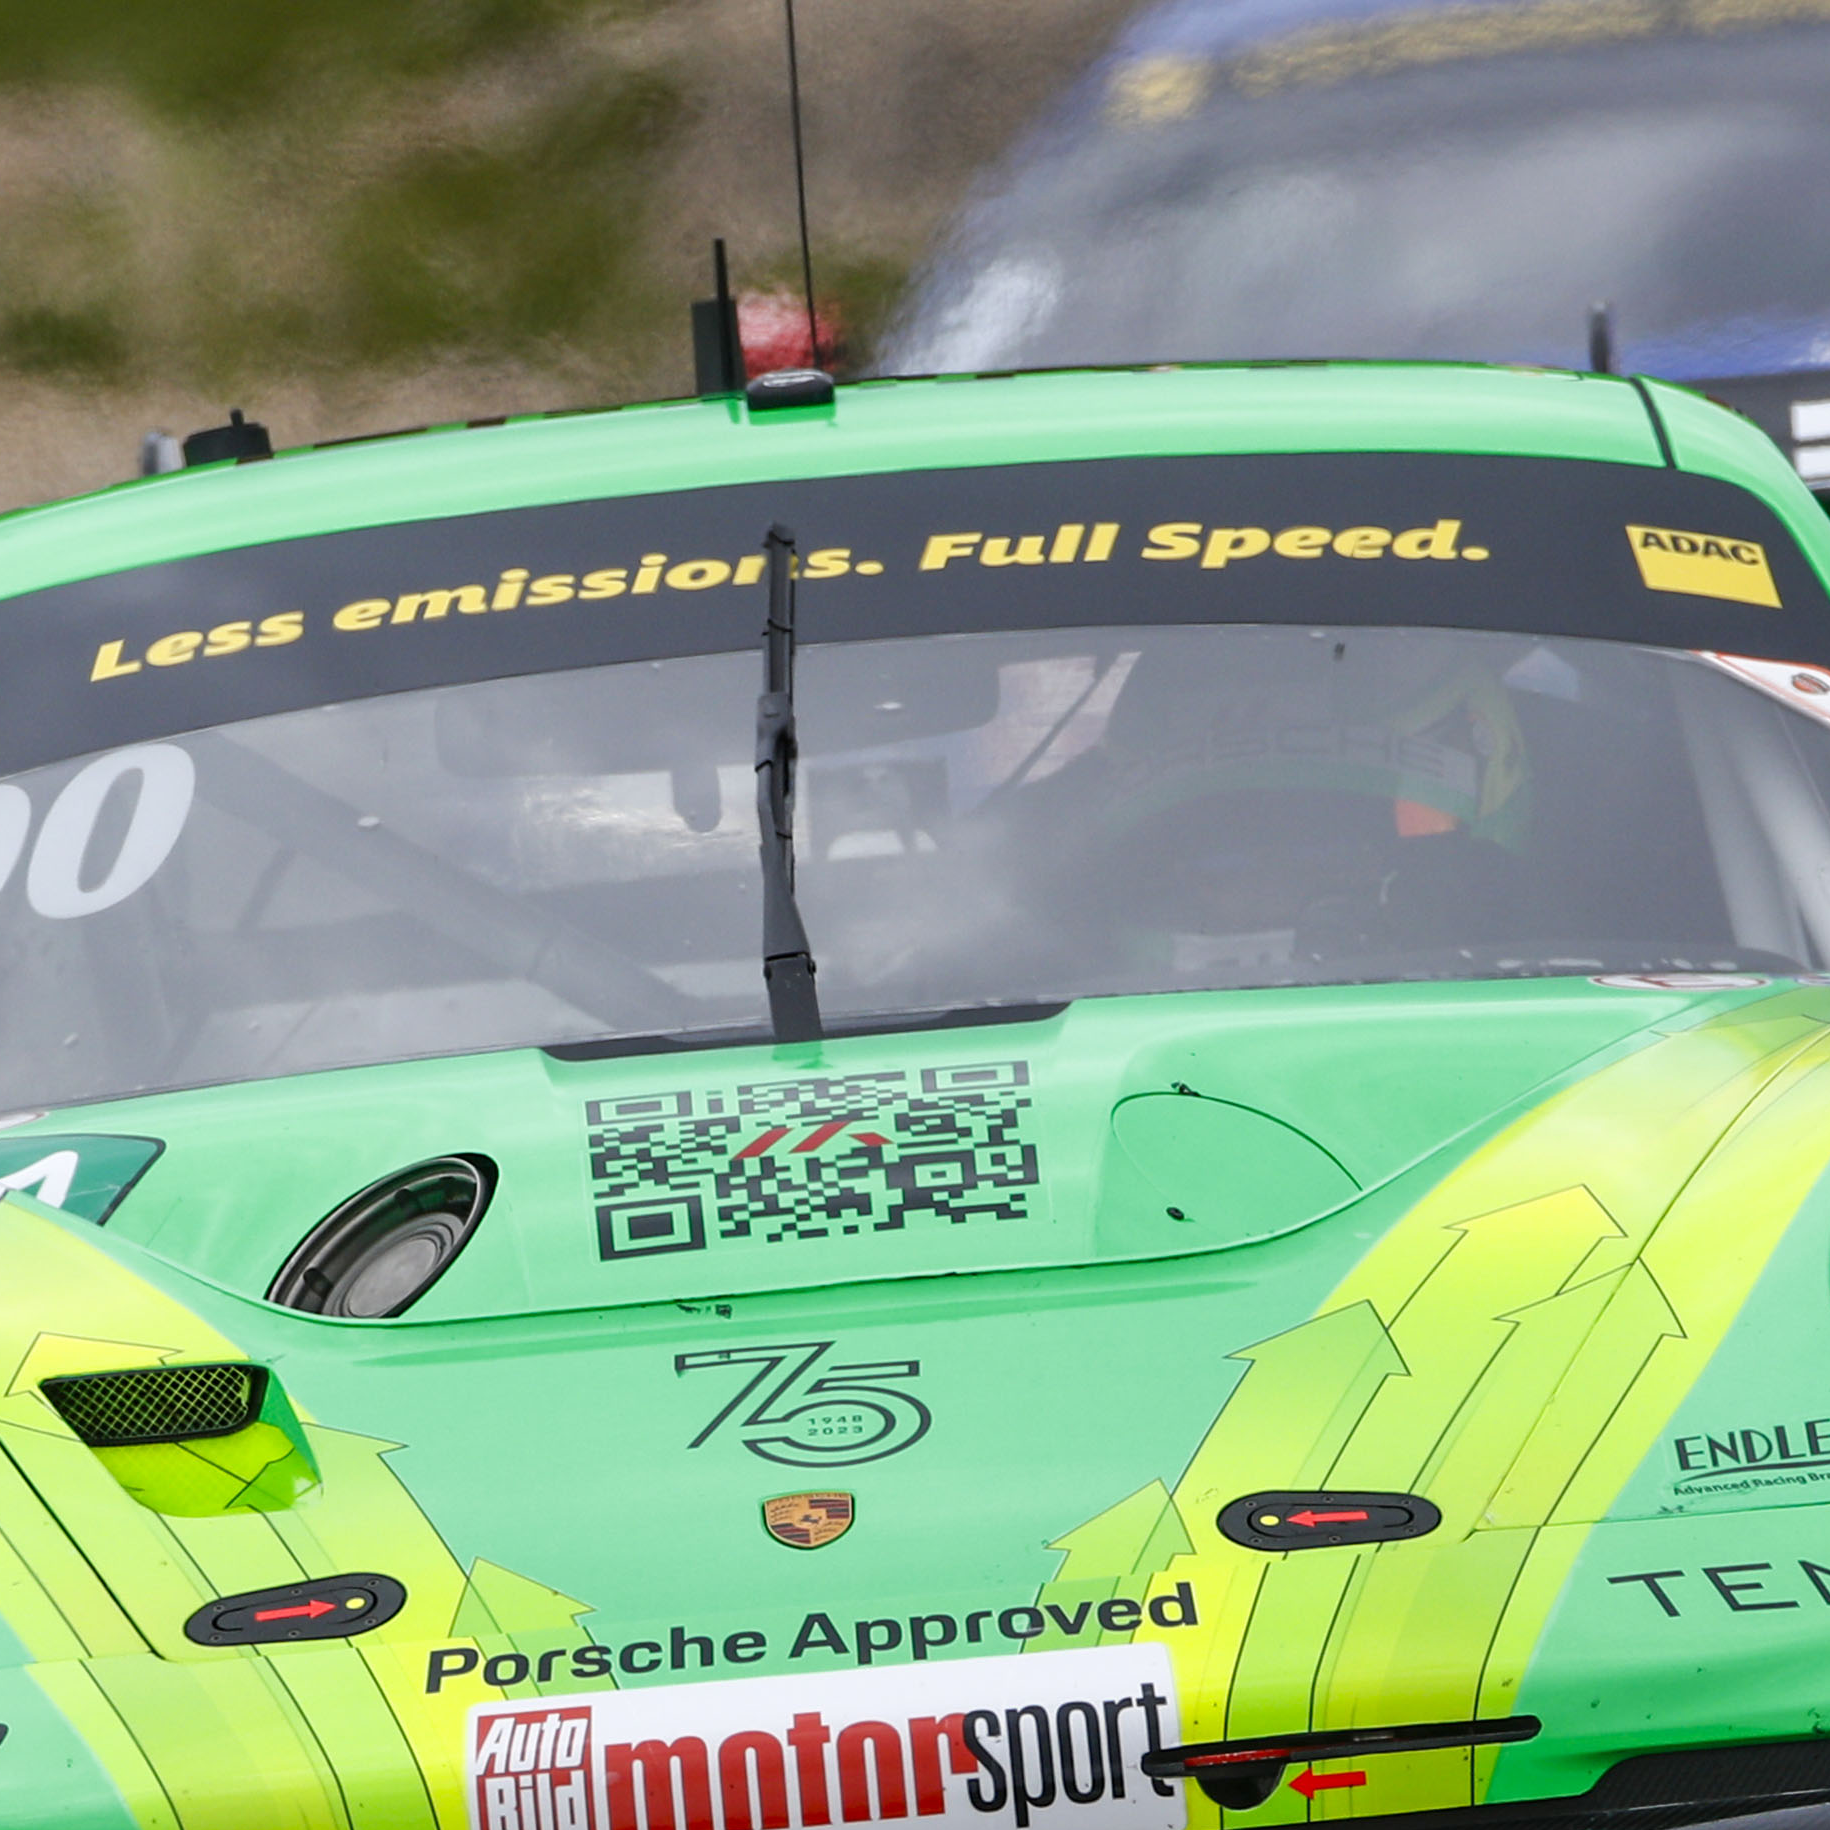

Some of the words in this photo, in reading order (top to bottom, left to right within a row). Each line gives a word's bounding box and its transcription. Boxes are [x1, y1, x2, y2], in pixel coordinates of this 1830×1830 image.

[1638, 530, 1761, 568] ADAC
[90, 610, 305, 682] Less
[917, 522, 1120, 572] Full
[1141, 518, 1491, 571] Speed.
[674, 1340, 933, 1468] 75
[806, 1414, 864, 1426] 1948
[806, 1425, 865, 1437] 2023
[1673, 1479, 1751, 1497] Advanced
[1753, 1473, 1807, 1490] Racing
[424, 1629, 768, 1695] Porsche
[789, 1581, 1200, 1662] Approved
[477, 1712, 590, 1776] Auto
